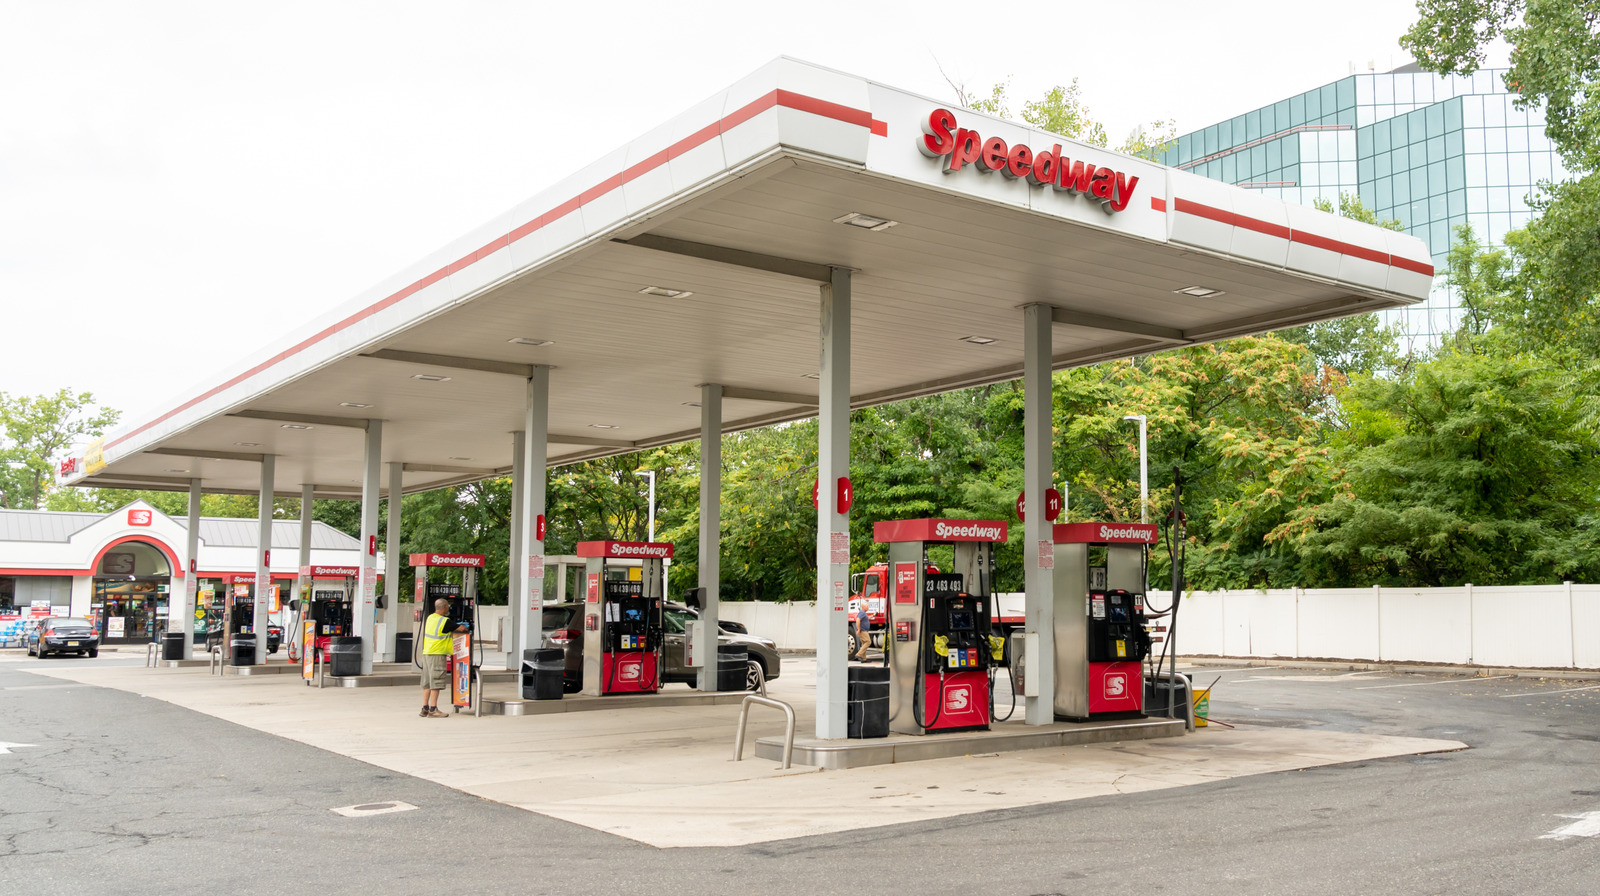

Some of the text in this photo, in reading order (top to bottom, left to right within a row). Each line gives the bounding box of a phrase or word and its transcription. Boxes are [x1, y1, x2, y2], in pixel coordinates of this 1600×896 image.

[917, 108, 1140, 214] Speedway
[844, 488, 848, 502] 1
[1050, 498, 1058, 510] 11
[540, 522, 545, 532] 3
[935, 522, 1001, 540] Speedway
[1100, 525, 1153, 542] Speedway
[610, 544, 668, 556] Speedway
[431, 555, 480, 565] Speedway
[315, 567, 357, 575] Speedway
[936, 580, 948, 591] 463
[950, 580, 961, 591] 493
[1136, 595, 1142, 605] 11
